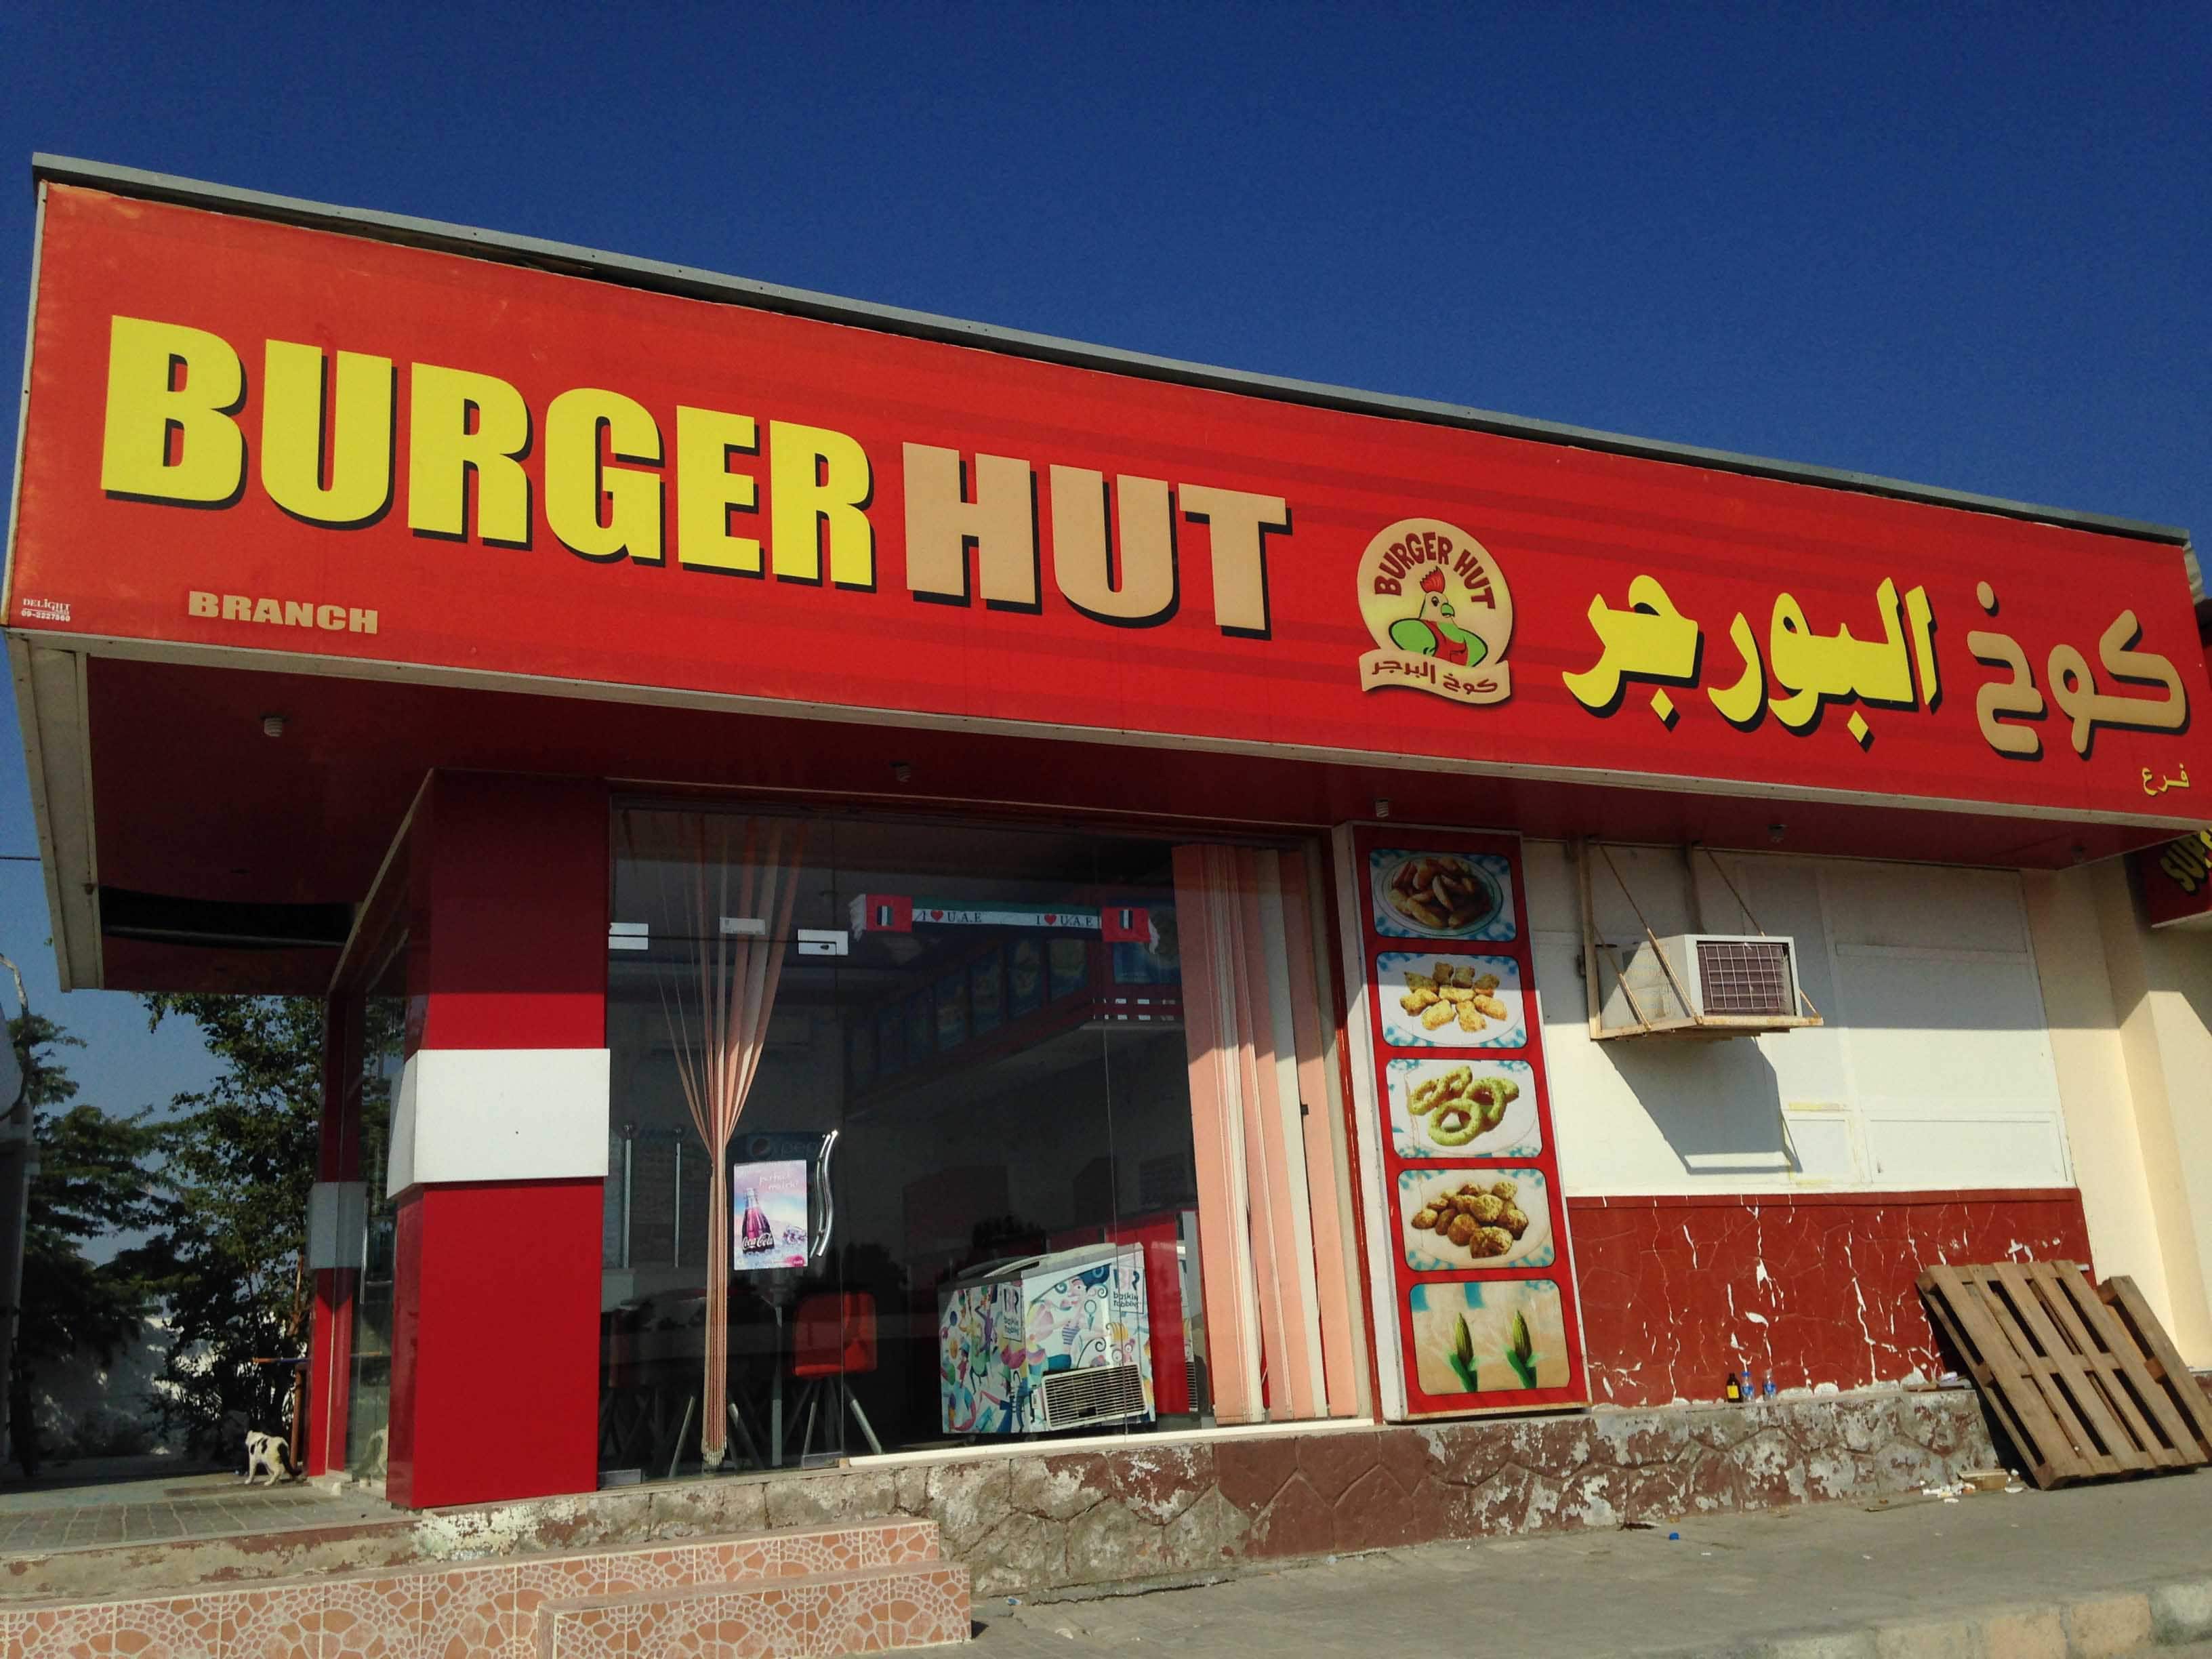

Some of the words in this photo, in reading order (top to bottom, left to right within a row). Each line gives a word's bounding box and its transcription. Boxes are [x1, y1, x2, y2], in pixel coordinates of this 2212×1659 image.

[101, 314, 874, 588] BURGER
[903, 443, 1289, 633] HUT
[1374, 531, 1453, 596] BURGER
[1453, 549, 1496, 609] HUT
[189, 591, 378, 634] BRANCH
[1372, 661, 1435, 684] البرجر
[1443, 673, 1497, 695] كوخ
[1563, 575, 1936, 743] البورجر
[1967, 580, 2186, 754] كوخ
[2142, 763, 2190, 796] فرع
